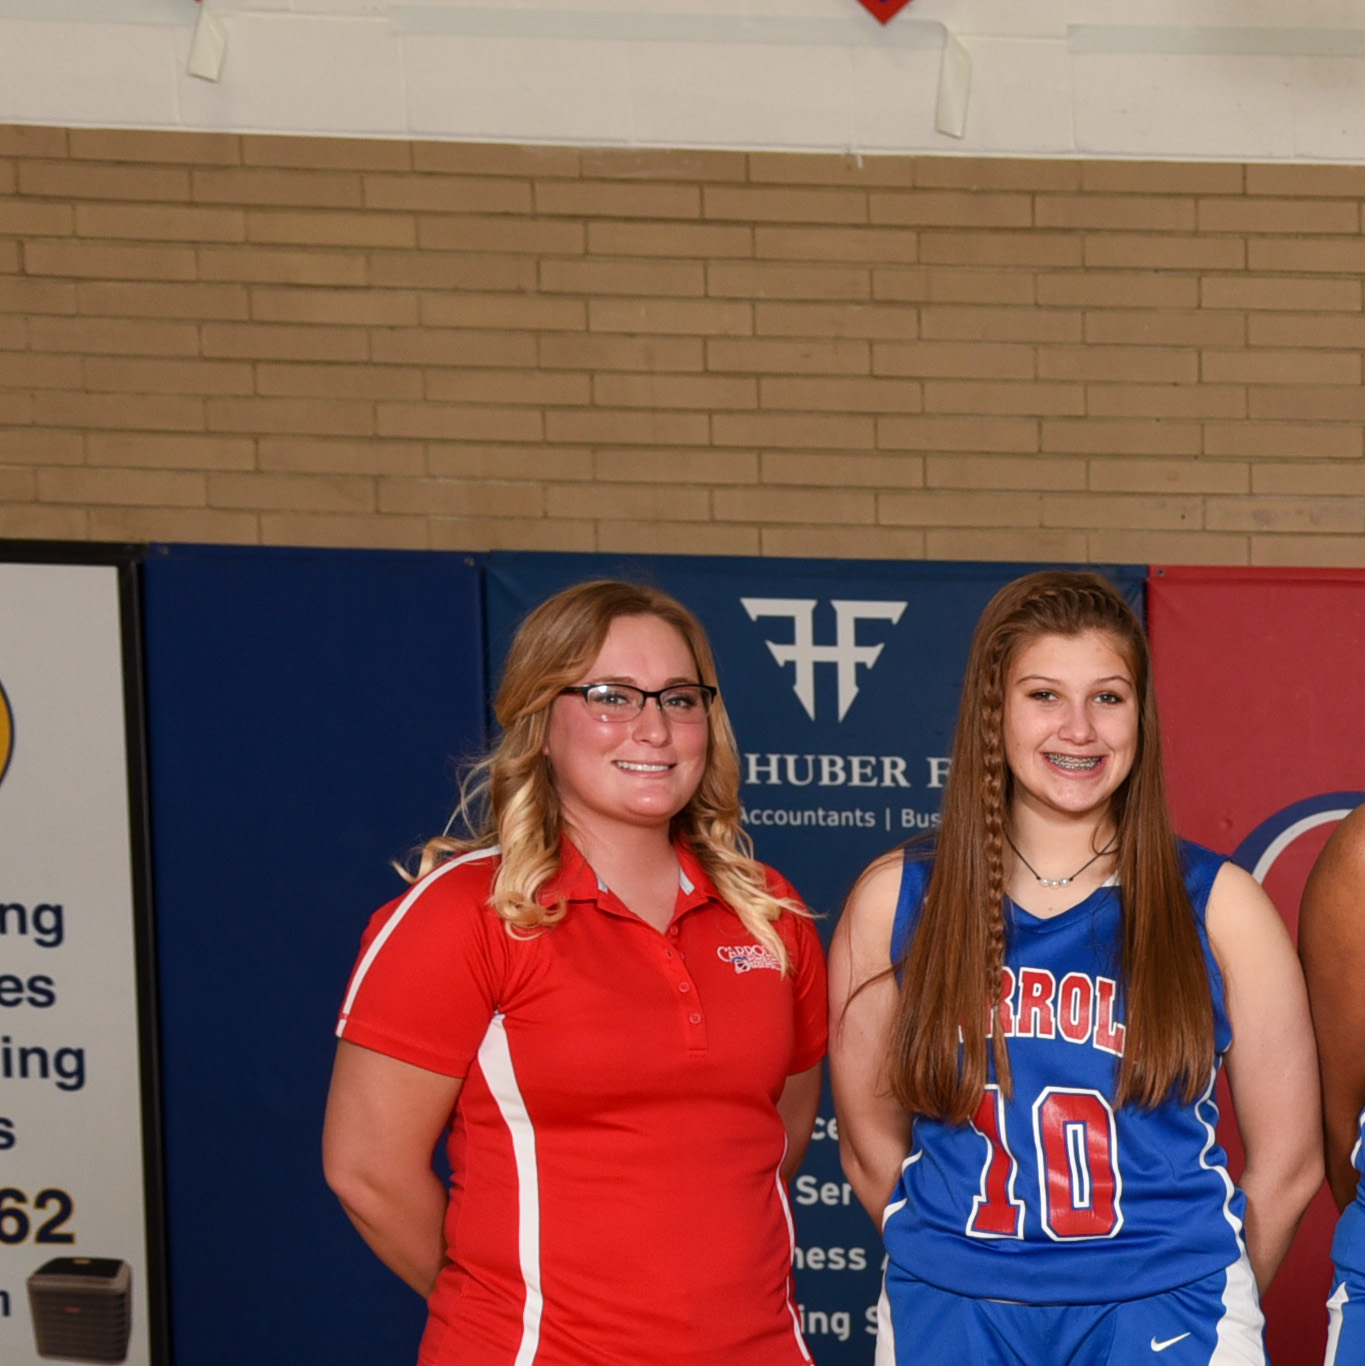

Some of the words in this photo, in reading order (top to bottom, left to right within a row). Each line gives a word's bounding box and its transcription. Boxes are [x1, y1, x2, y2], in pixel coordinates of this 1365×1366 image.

[745, 752, 911, 788] HUBER
[741, 806, 876, 828] Accountants
[965, 1084, 1124, 1241] 10
